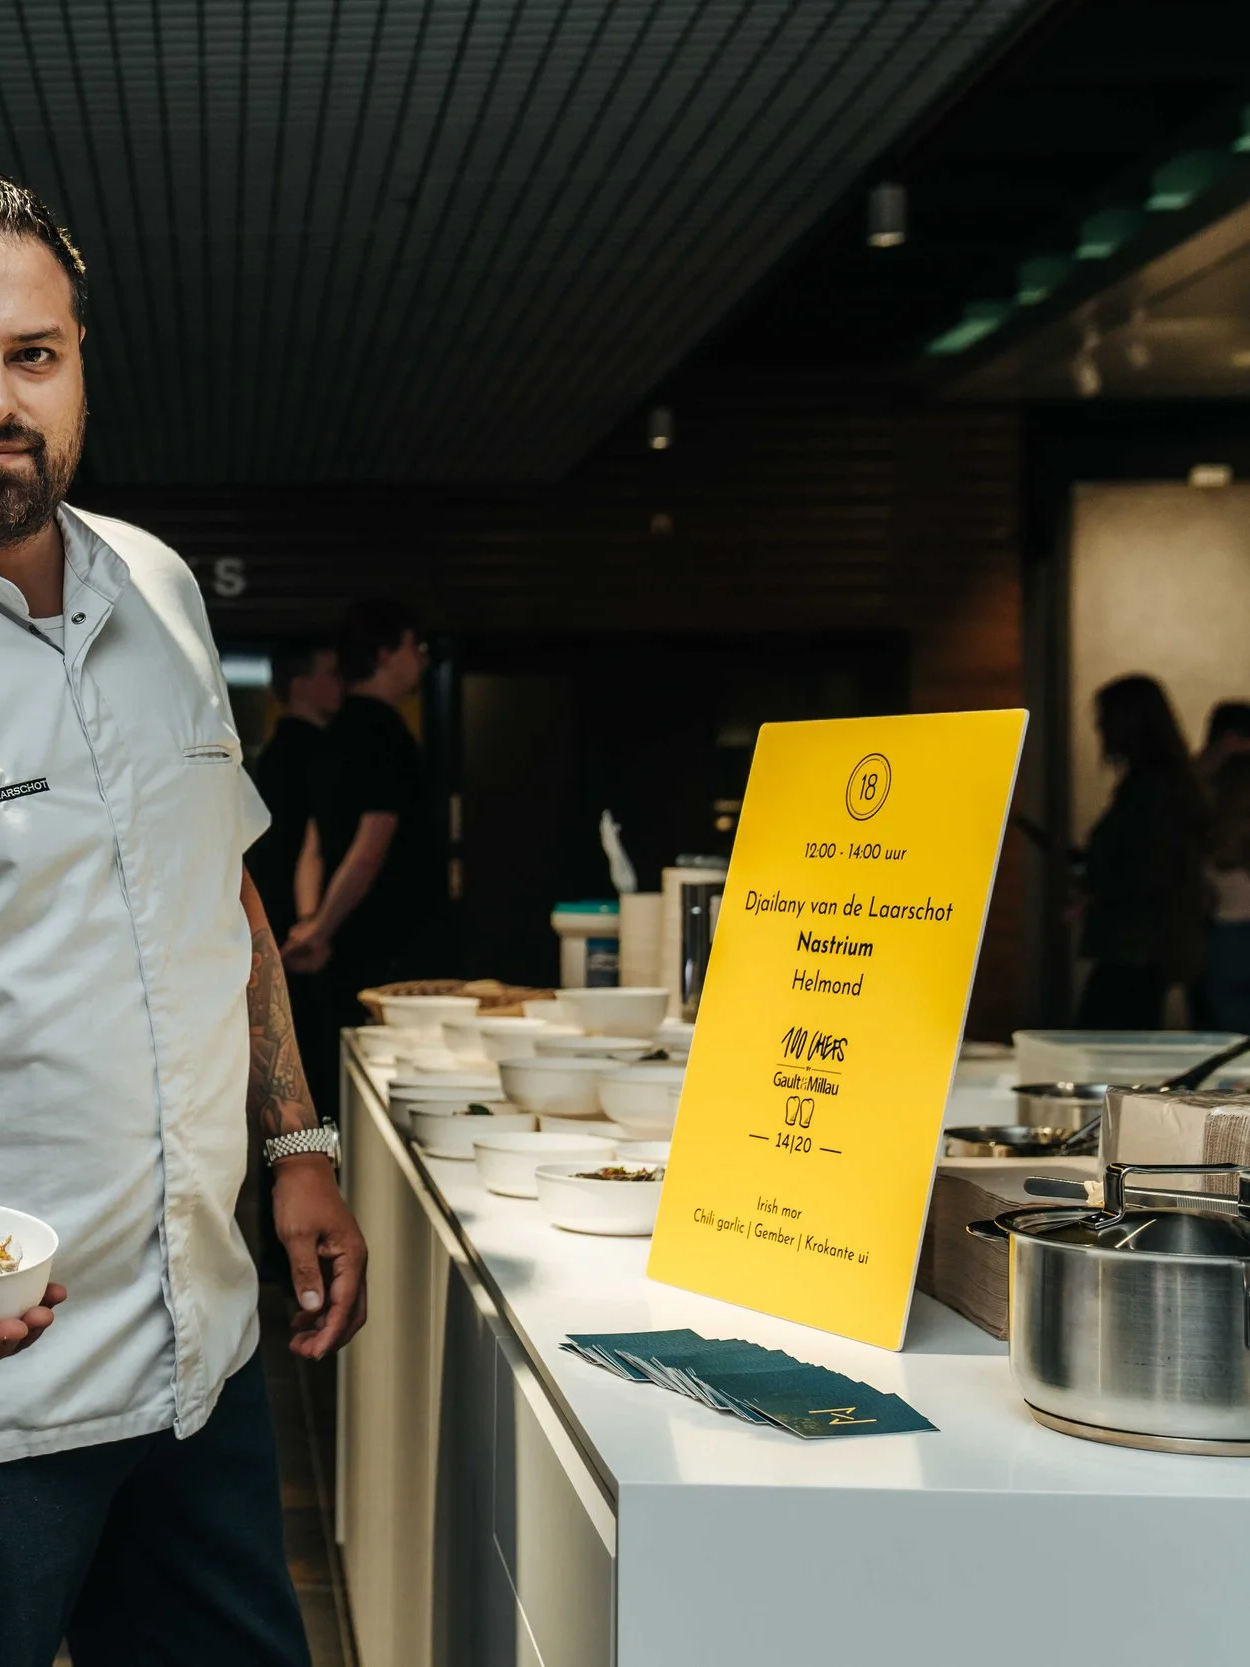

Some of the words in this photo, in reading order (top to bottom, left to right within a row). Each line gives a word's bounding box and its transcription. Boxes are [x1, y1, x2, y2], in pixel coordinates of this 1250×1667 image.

[859, 773, 878, 801] 18
[805, 842, 837, 859] 12:00
[848, 842, 882, 860] 14:00
[884, 849, 908, 861] uur
[745, 890, 806, 919] Djailany
[810, 899, 838, 916] van
[842, 893, 863, 917] de
[868, 895, 954, 922] Laarschot
[796, 930, 874, 958] Nastrium
[791, 968, 865, 997] Helmond
[780, 1025, 809, 1060] 100
[756, 1196, 778, 1215] Irish
[781, 1206, 803, 1220] mor
[693, 1208, 716, 1227] Chili
[716, 1216, 746, 1234] garlic
[754, 1223, 796, 1247] Gember
[804, 1234, 855, 1262] Krokante
[857, 1251, 870, 1265] ui
